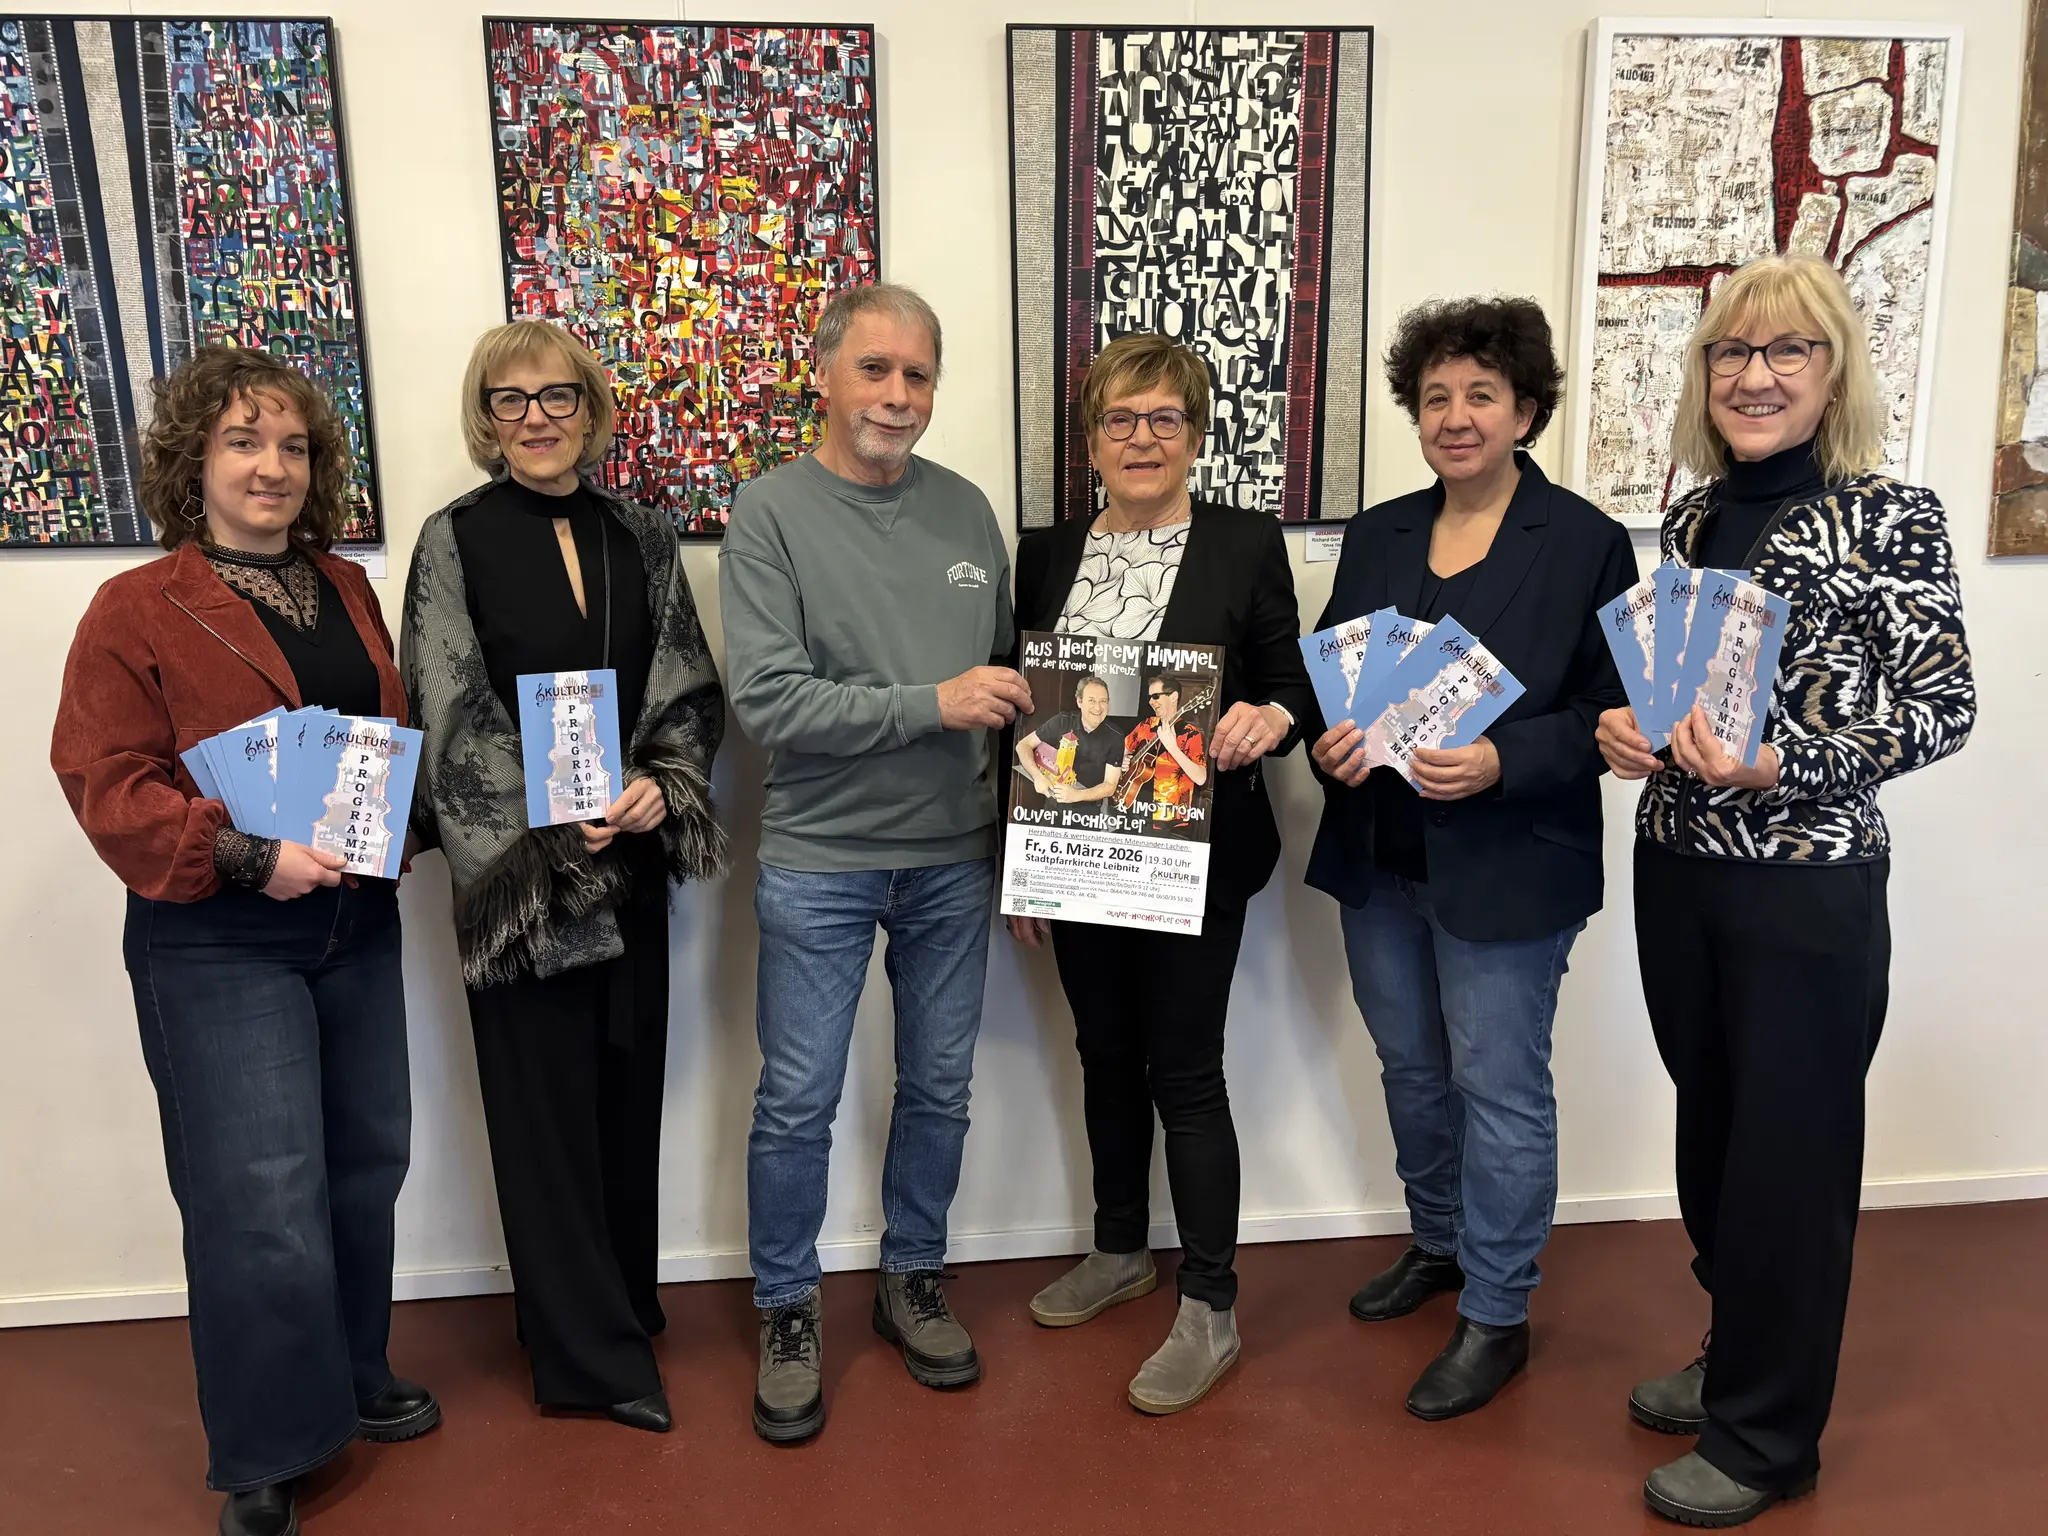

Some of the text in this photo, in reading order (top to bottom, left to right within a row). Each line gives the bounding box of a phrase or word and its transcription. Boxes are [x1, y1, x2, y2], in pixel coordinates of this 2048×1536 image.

[946, 561, 988, 584] FORTUNE
[1723, 592, 1763, 617] KULTUR
[1025, 641, 1052, 657] AUS
[1042, 658, 1057, 669] der
[1453, 644, 1493, 683] KULTUR
[545, 685, 588, 697] KULTUR
[336, 731, 389, 748] KULTUR
[568, 705, 586, 811] PROGRAMM
[344, 755, 369, 863] PROGRAMM
[1028, 828, 1062, 838] Herzhaftes
[1025, 838, 1046, 855] Fr.,
[1050, 841, 1063, 854] 6.
[1066, 842, 1104, 859] März
[1108, 847, 1143, 862] 2026
[1174, 859, 1192, 869] Uhr
[1025, 853, 1140, 873] Stadtpfarrkirche Leibnitz
[1157, 871, 1190, 882] KULTUR
